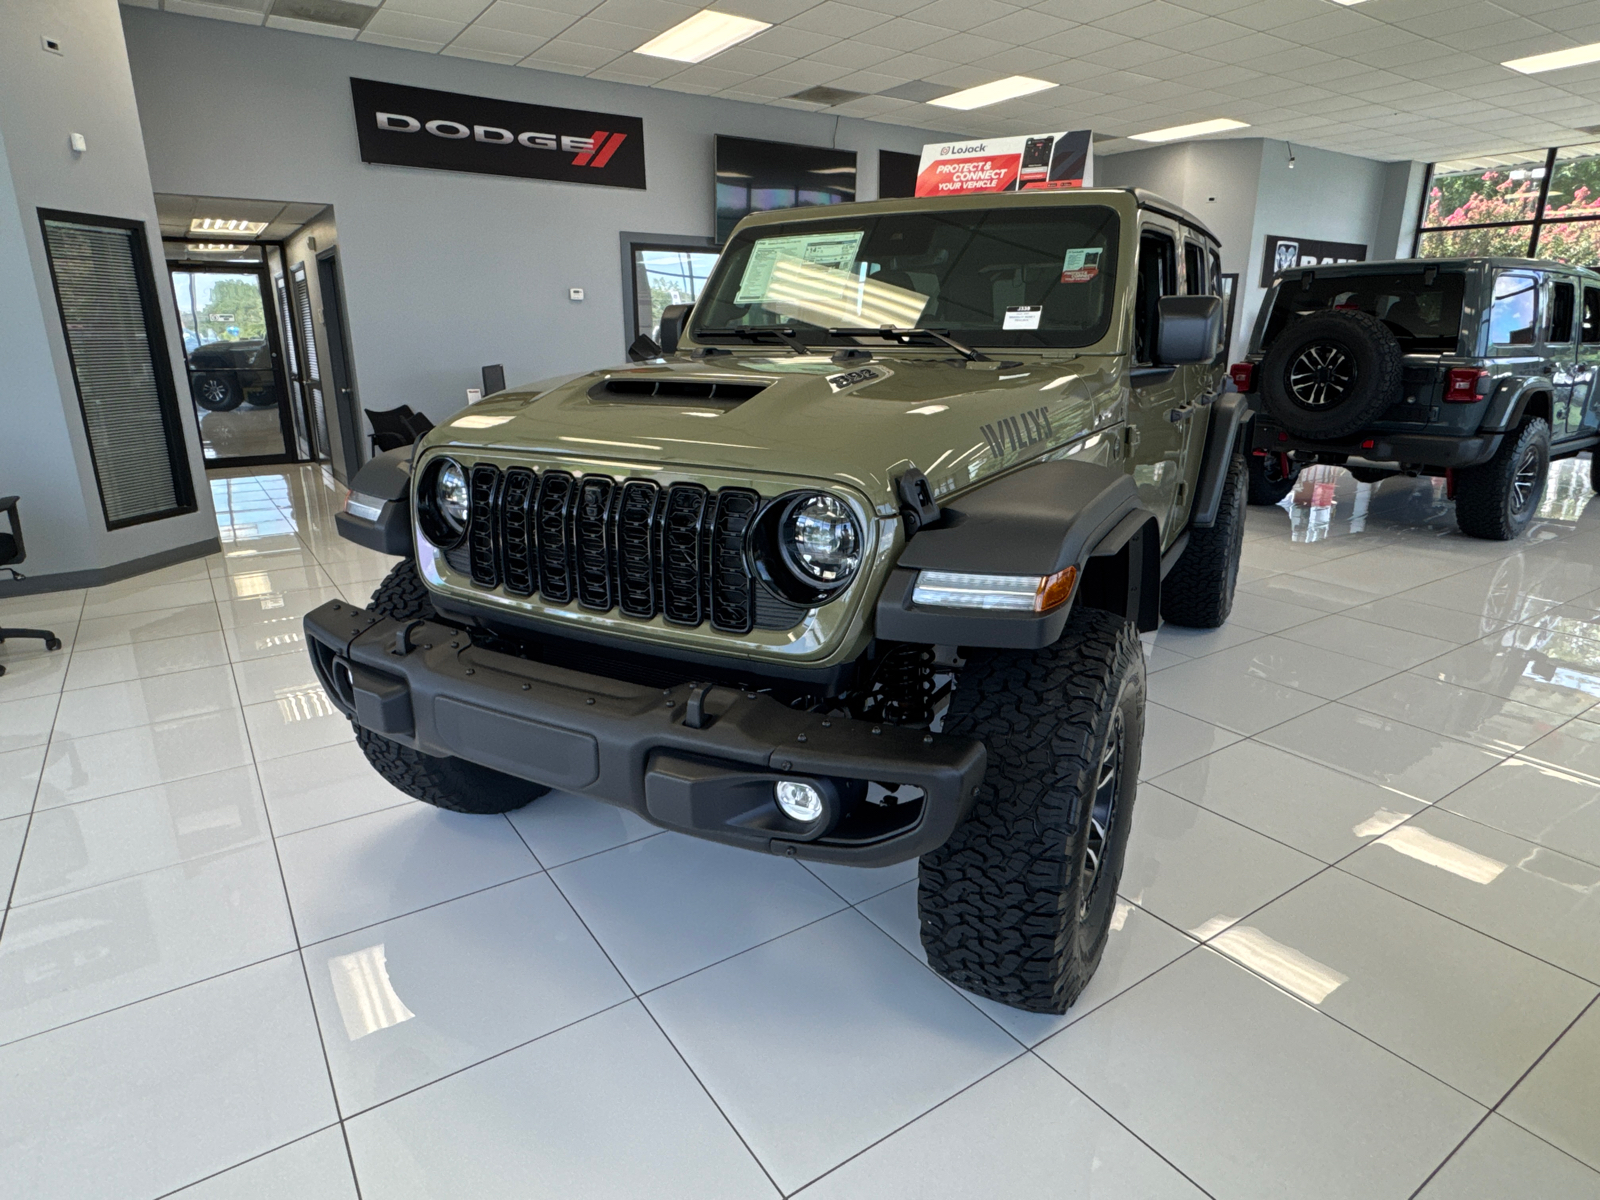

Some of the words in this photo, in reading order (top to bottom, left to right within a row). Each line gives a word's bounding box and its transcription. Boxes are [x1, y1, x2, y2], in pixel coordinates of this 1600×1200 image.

[375, 111, 596, 154] DODGE
[951, 143, 986, 155] LoJack
[936, 162, 984, 174] PROTECT
[953, 169, 1007, 182] CONNECT
[938, 182, 962, 191] YOUR
[963, 179, 998, 189] VEHICLE
[829, 369, 879, 388] 392
[979, 406, 1053, 458] WILLYS
